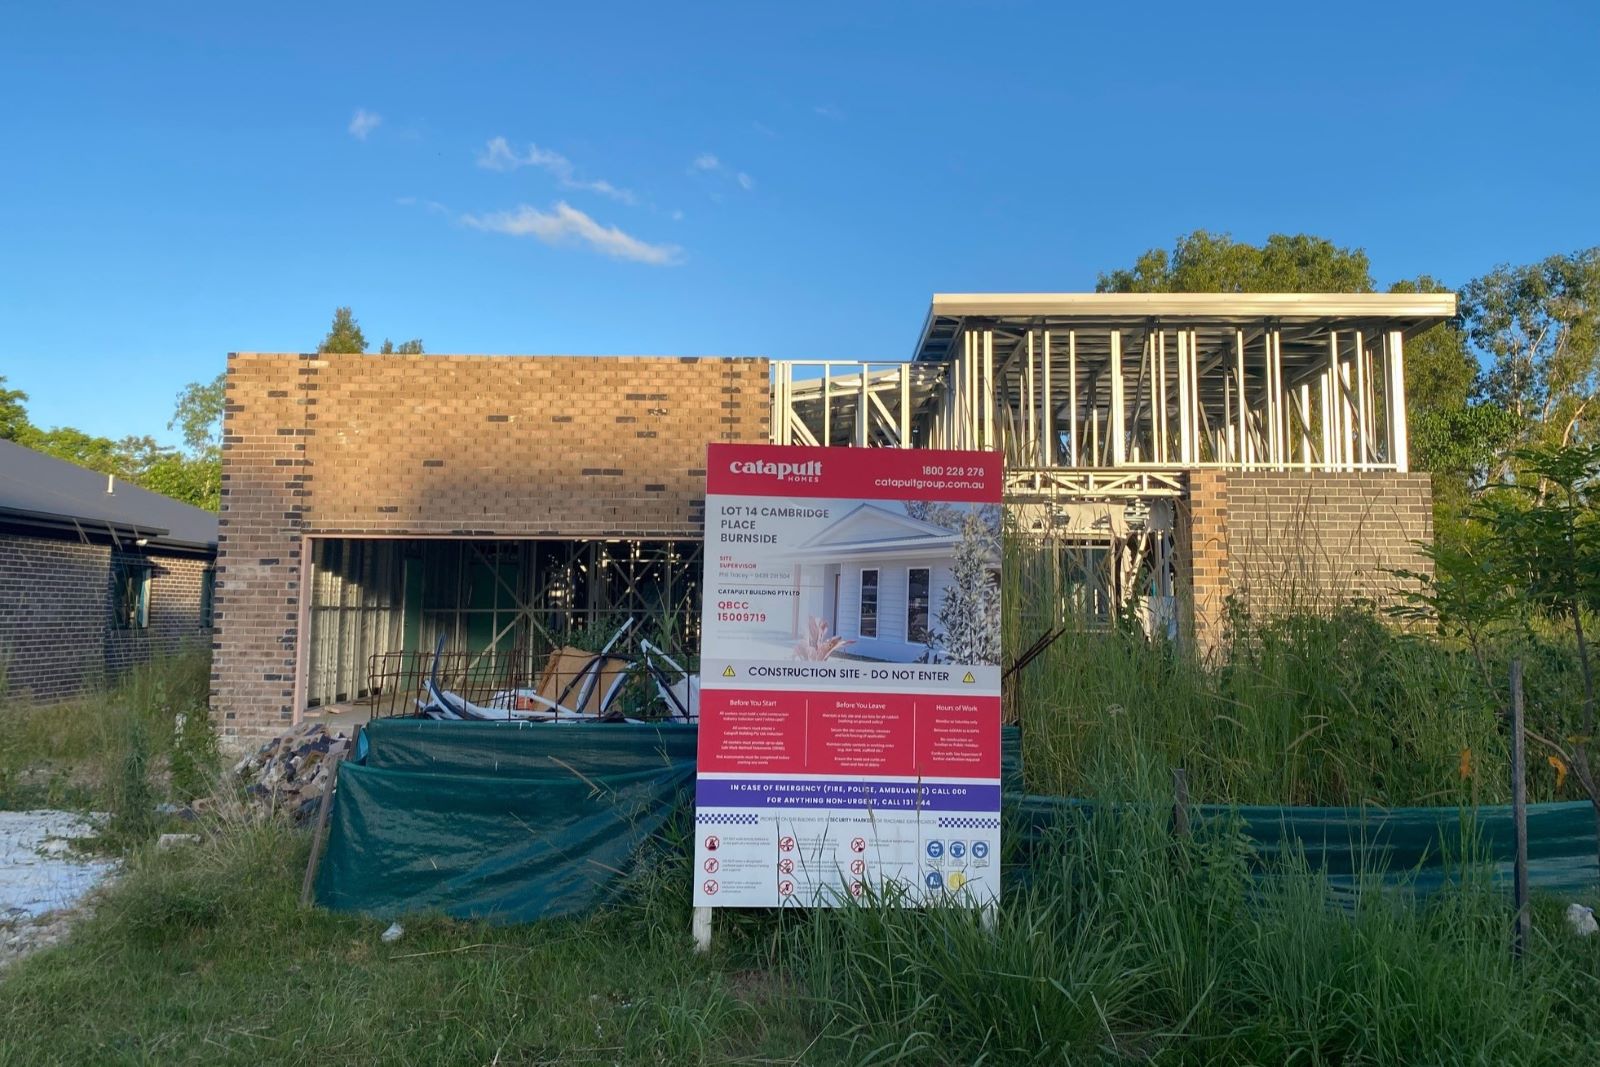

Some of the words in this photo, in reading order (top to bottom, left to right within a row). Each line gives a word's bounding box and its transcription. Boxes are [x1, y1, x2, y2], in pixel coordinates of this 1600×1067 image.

[729, 459, 823, 480] catapult
[922, 465, 944, 476] 1800
[946, 466, 965, 477] 228
[967, 467, 985, 477] 278
[788, 475, 820, 483] HOMES
[874, 478, 985, 489] catapultgroup.com.au
[721, 506, 742, 516] LOT
[745, 506, 758, 516] 14
[761, 507, 830, 519] CAMBRIDGE
[720, 519, 756, 530] PLACE
[720, 533, 778, 544] BURNSIDE
[718, 601, 750, 610] QBCC
[718, 612, 766, 622] 15009719
[748, 666, 836, 679] CONSTRUCTION
[839, 669, 860, 679] SITE
[871, 669, 889, 680] DO
[892, 670, 916, 681] NOT
[918, 671, 950, 682] ENTER
[729, 699, 750, 707] Before
[750, 699, 762, 707] You
[762, 699, 777, 707] Start
[836, 701, 856, 709] Before
[823, 784, 846, 794] (FIRE,
[847, 786, 877, 794] POLICE,
[879, 787, 930, 795] AMBULANE)
